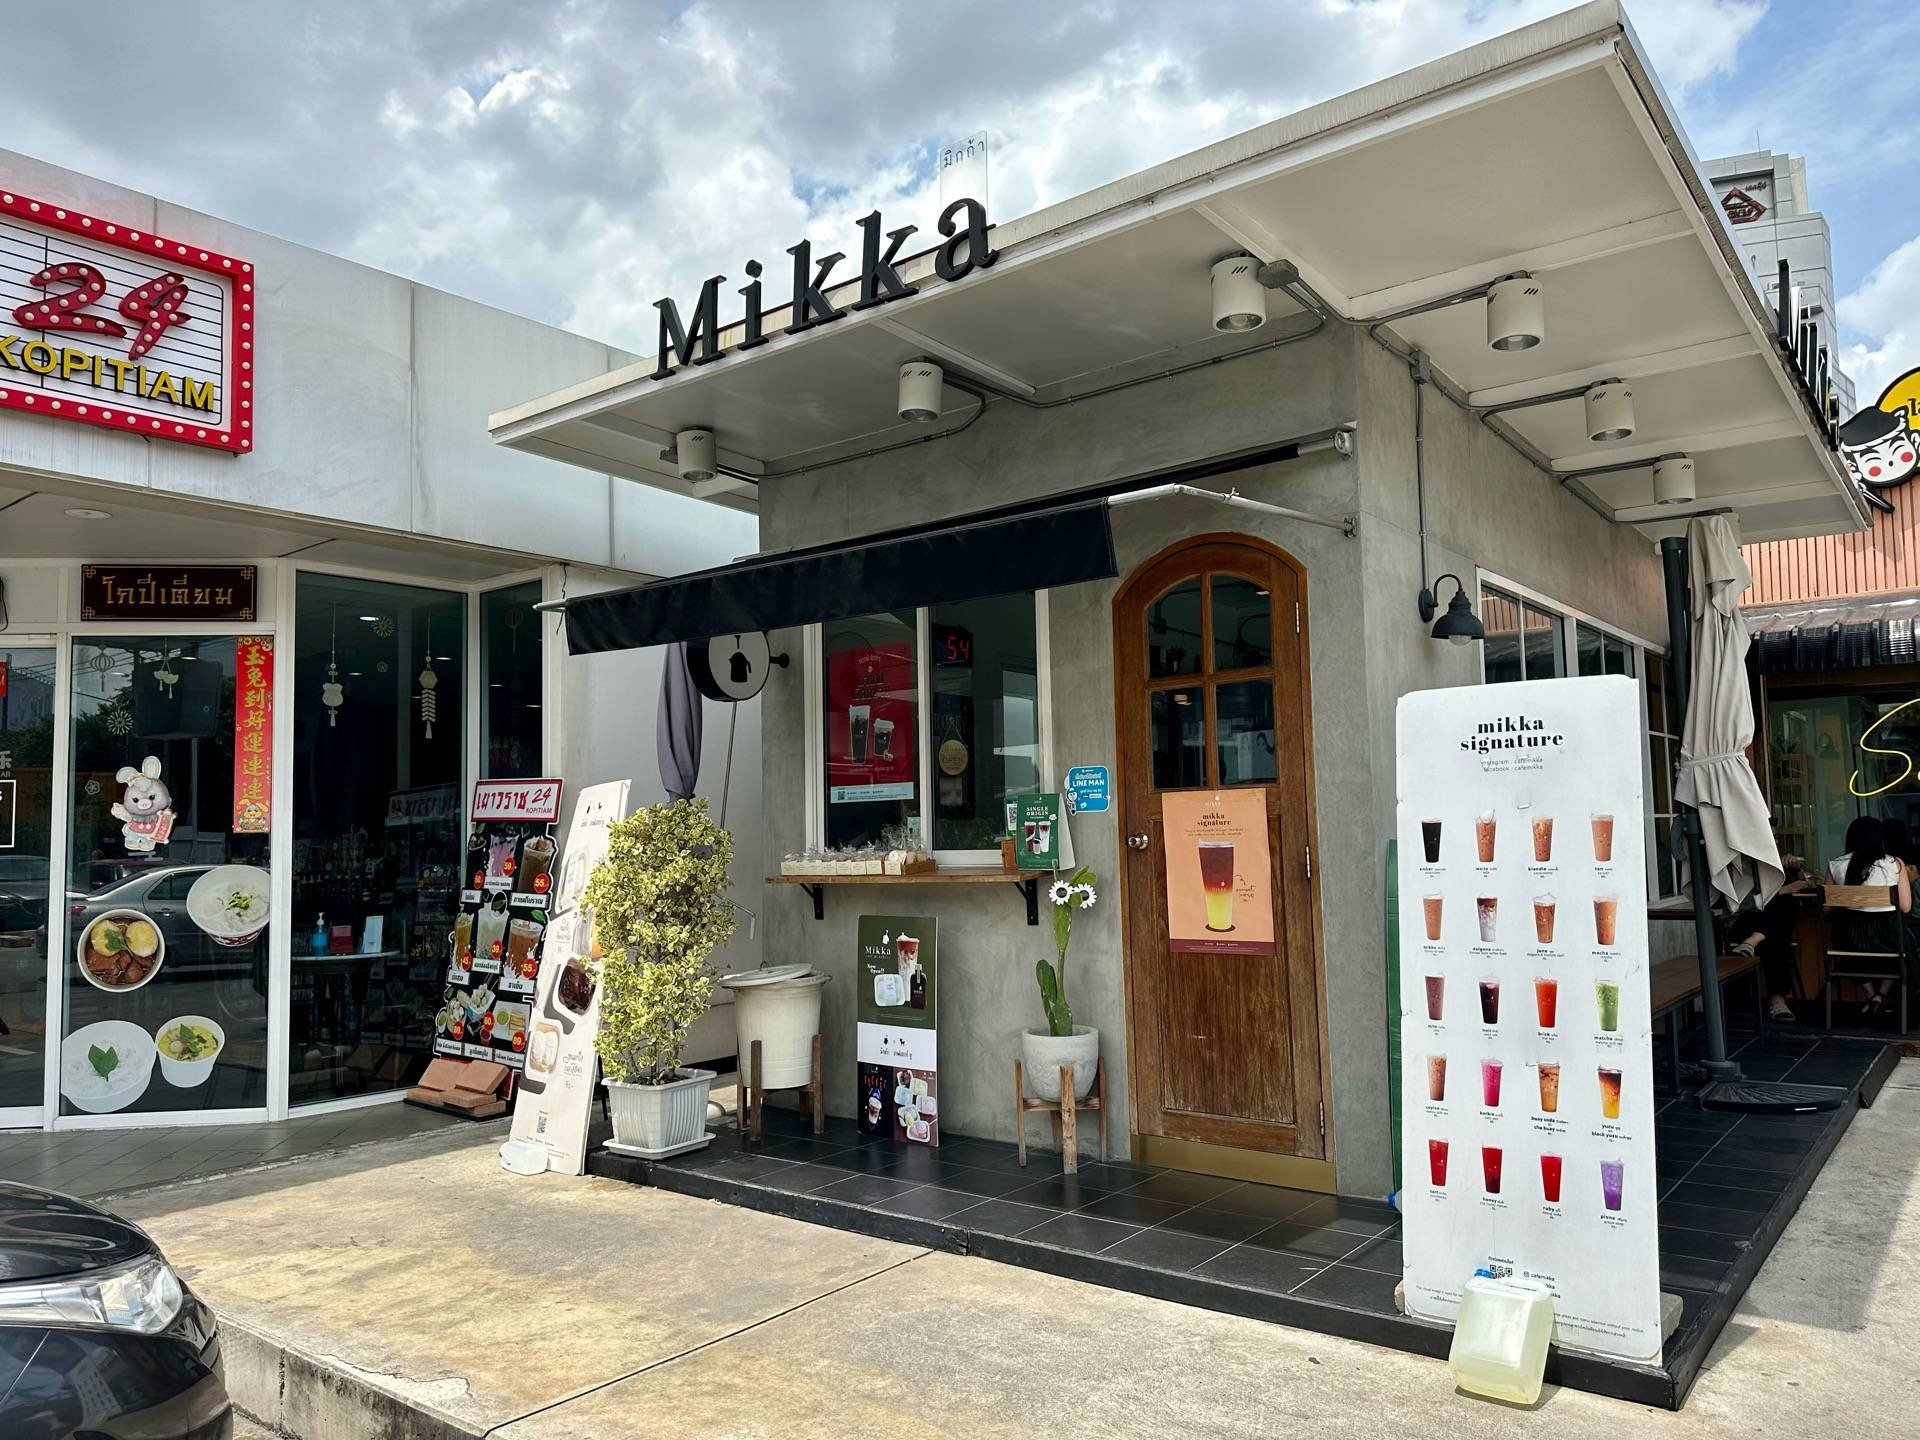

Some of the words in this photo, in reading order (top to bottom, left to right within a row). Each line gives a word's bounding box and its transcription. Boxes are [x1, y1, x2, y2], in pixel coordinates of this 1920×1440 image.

[650, 197, 1000, 381] Mikka
[12, 262, 192, 361] 24
[1477, 715, 1545, 734] mikka
[1460, 734, 1564, 755] signature
[1072, 779, 1088, 787] LINE
[1088, 779, 1105, 787] MAN
[531, 785, 552, 806] 24
[1197, 820, 1232, 828] signature
[1202, 812, 1225, 820] mikka
[864, 945, 891, 955] Mikka
